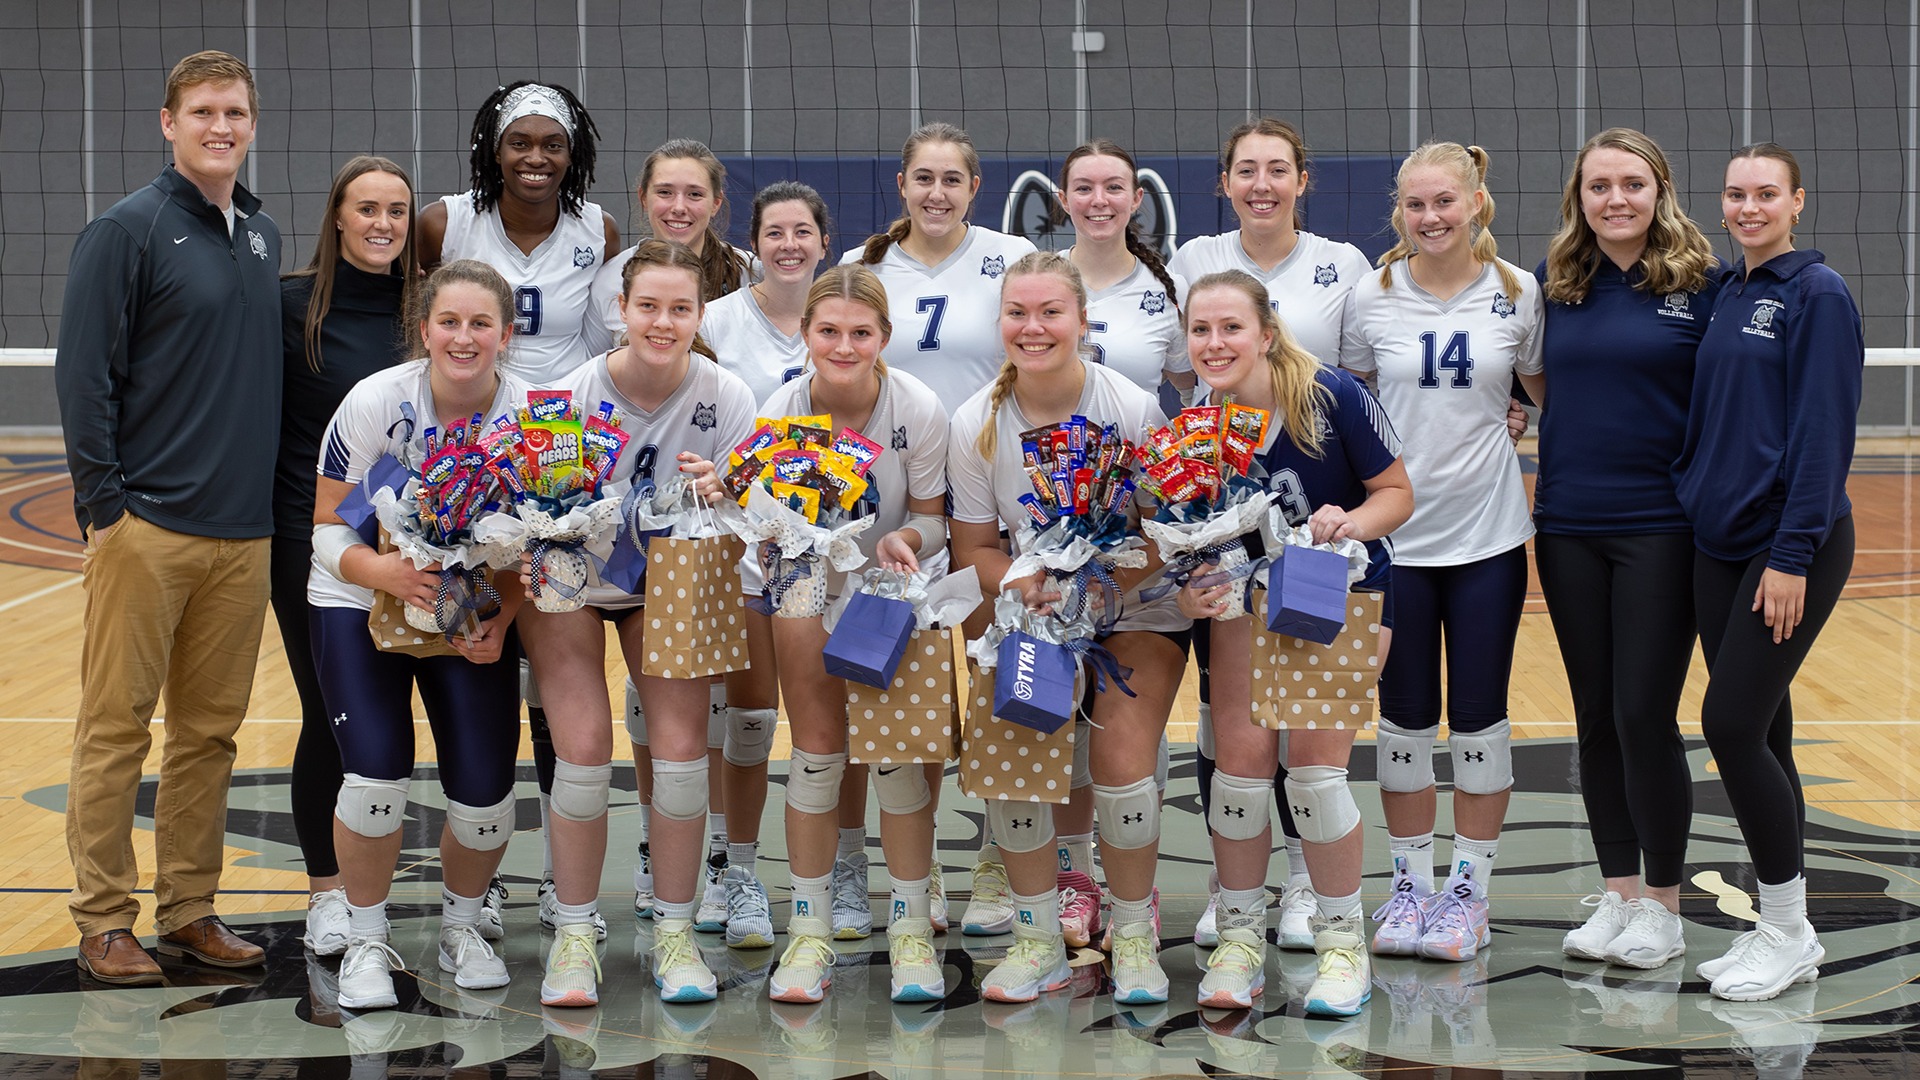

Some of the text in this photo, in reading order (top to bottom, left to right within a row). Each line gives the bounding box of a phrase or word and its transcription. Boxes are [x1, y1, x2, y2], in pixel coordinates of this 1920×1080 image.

[512, 285, 543, 337] 9
[916, 295, 949, 351] 7
[1657, 309, 1694, 319] VOLLEYBALL
[1418, 330, 1474, 388] 14
[537, 446, 578, 467] HEADS
[553, 432, 578, 450] AIR
[1270, 467, 1312, 525] 3
[1016, 641, 1036, 683] TYRA
